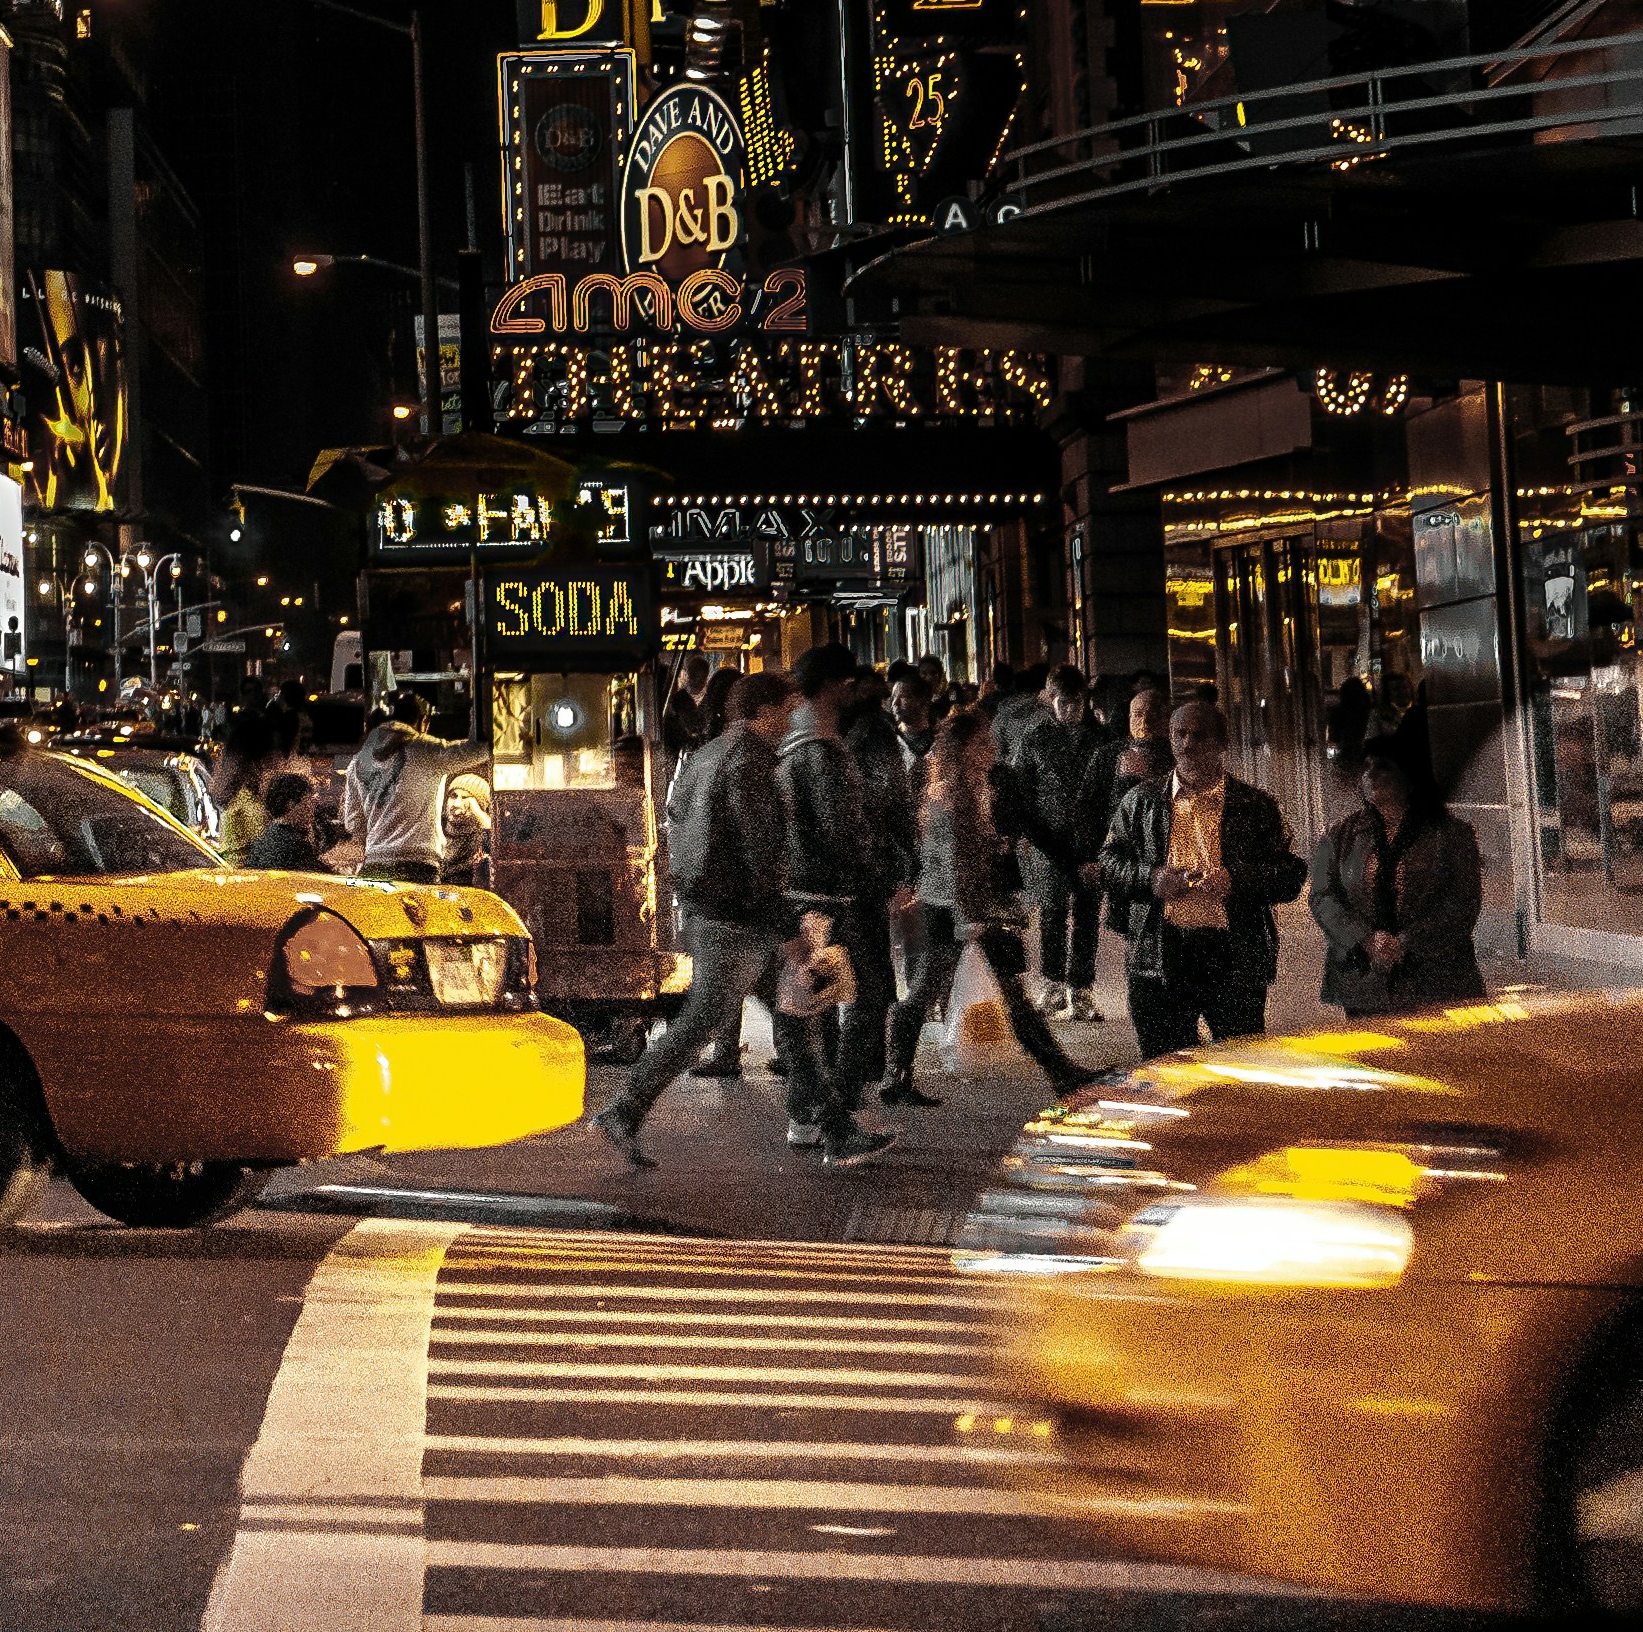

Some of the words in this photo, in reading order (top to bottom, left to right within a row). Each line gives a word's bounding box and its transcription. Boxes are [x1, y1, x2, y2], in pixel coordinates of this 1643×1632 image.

[906, 72, 945, 131] 25
[634, 96, 680, 173] DAVE
[688, 96, 737, 155] AND
[636, 174, 739, 265] D&B
[943, 202, 970, 233] A
[491, 269, 742, 334] amc
[492, 341, 1051, 419] THEATRES
[495, 581, 638, 636] SODA
